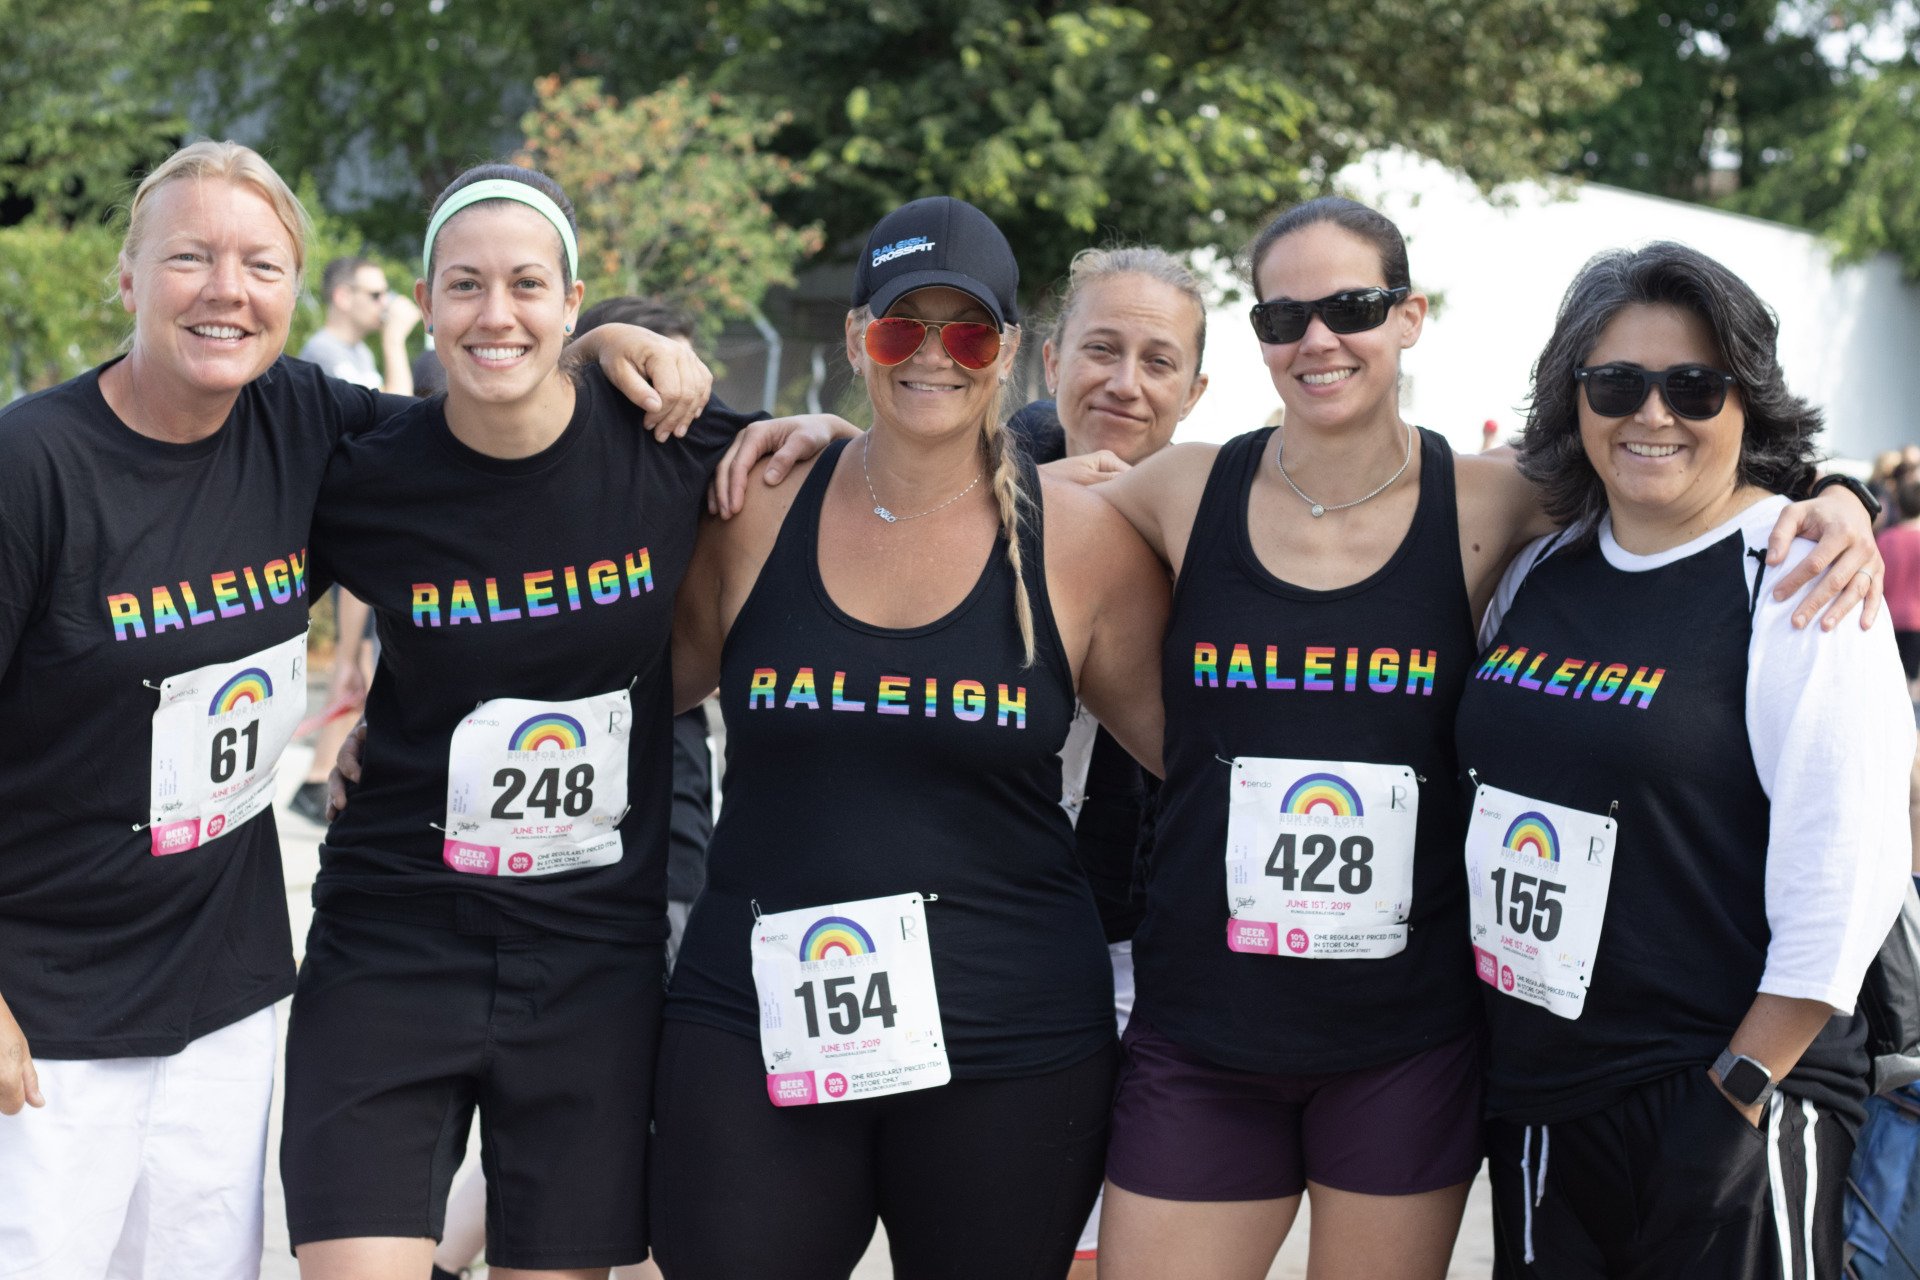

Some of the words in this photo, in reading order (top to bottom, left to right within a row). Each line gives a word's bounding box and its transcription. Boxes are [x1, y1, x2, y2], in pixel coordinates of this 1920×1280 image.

[872, 236, 927, 259] RALEIGH
[872, 242, 935, 267] CROSSFIT
[412, 546, 655, 627] RALEIGH
[106, 547, 306, 642] RALEIGH
[1194, 642, 1438, 696] RALEIGH
[1475, 644, 1667, 710] RALEIGH
[749, 667, 1027, 730] RALEIGH
[608, 710, 623, 733] R
[210, 718, 260, 784] 61
[490, 763, 596, 820] 248
[1247, 780, 1272, 788] pendo
[1391, 785, 1408, 809] R
[165, 826, 190, 840] BEER
[511, 826, 534, 835] JUNE
[161, 834, 193, 849] TICKET
[459, 847, 486, 860] BEER
[1587, 836, 1605, 863] R
[454, 856, 490, 869] TICKET
[512, 862, 529, 870] OFF
[1264, 833, 1374, 895] 428
[1286, 899, 1309, 909] JUNE
[1331, 901, 1352, 911] 2019
[1491, 867, 1567, 942] 155
[899, 915, 917, 941] R
[1239, 927, 1265, 938] BEER
[766, 934, 789, 943] pendo
[1236, 936, 1270, 947] TICKET
[1291, 933, 1305, 942] 10%
[1291, 941, 1306, 949] OFF
[794, 971, 898, 1038] 154
[819, 1043, 841, 1054] JUNE
[861, 1038, 881, 1049] 2019
[851, 1073, 865, 1081] ONE
[866, 1068, 902, 1079] REGULARLY
[904, 1063, 927, 1073] PRICED
[780, 1078, 805, 1088] BEER
[828, 1078, 843, 1086] 10%
[828, 1085, 845, 1093] OFF
[860, 1079, 880, 1087] STORE
[882, 1076, 899, 1084] ONLY
[777, 1087, 809, 1099] TICKET
